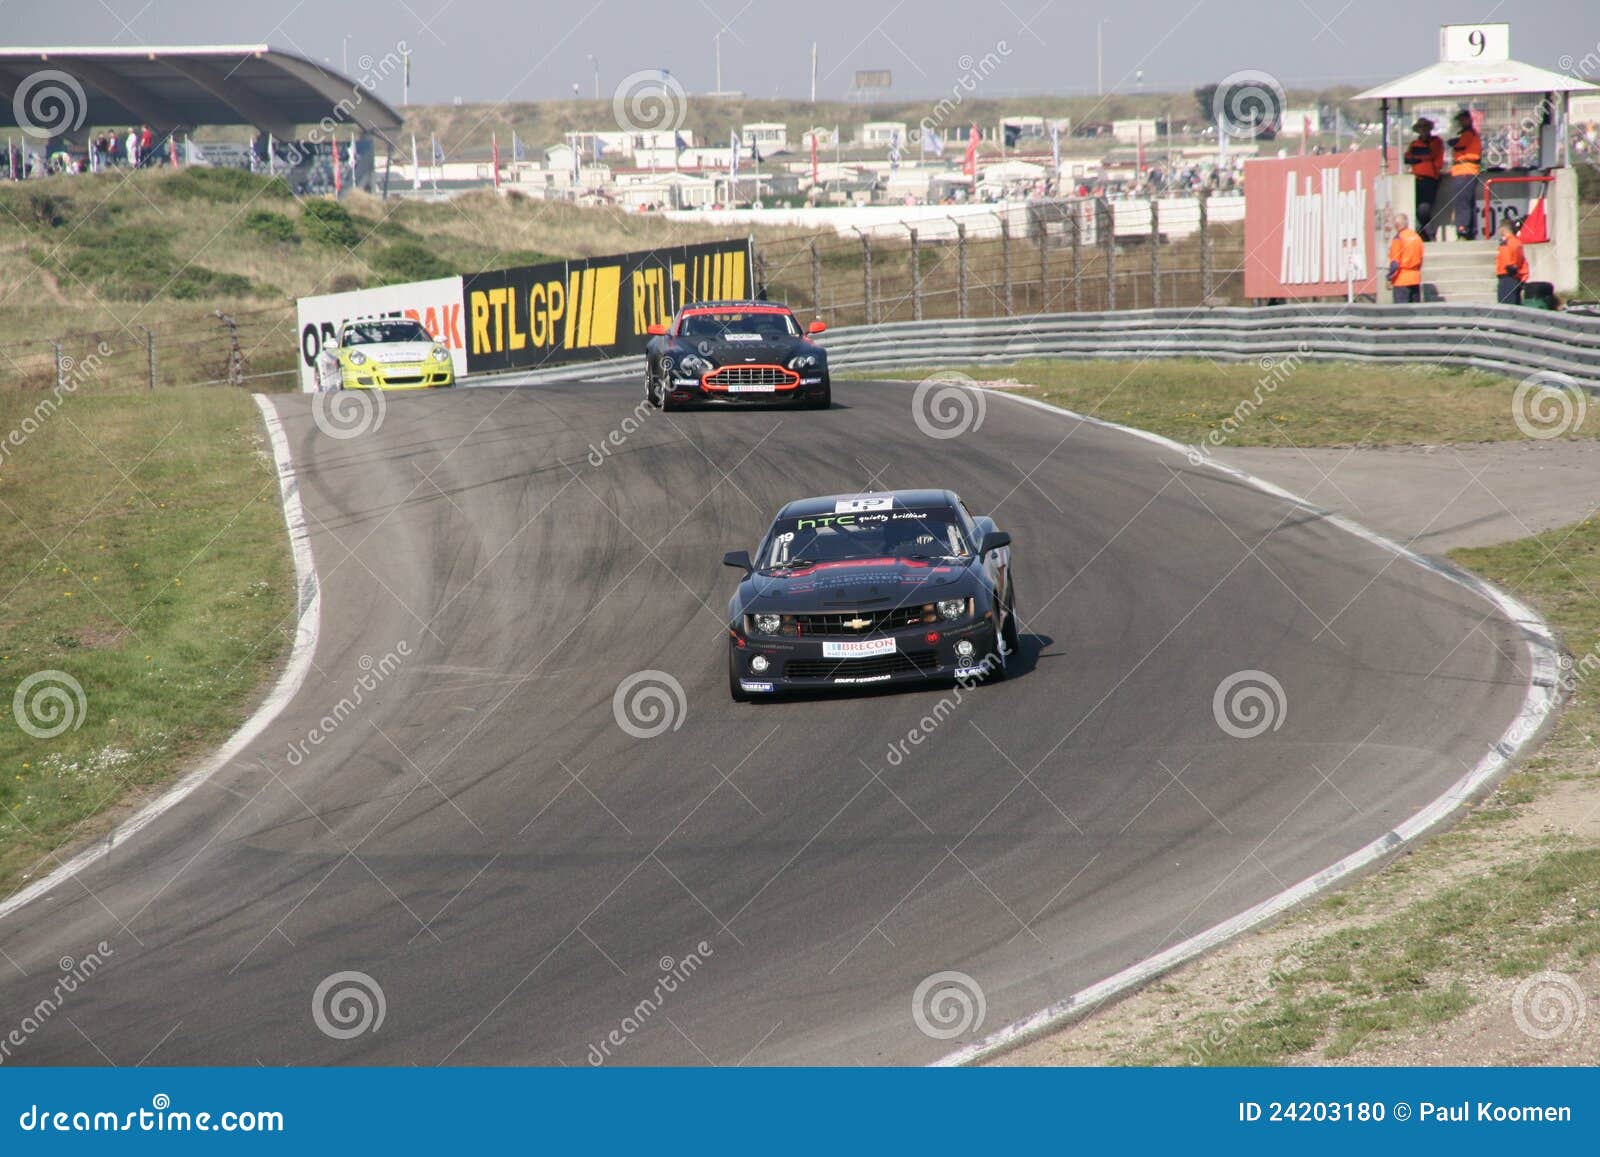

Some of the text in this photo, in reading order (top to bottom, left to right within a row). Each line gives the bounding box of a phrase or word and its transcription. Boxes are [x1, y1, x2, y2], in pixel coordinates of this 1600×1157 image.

[1467, 29, 1486, 57] 9
[471, 281, 566, 355] RTL GP
[778, 532, 795, 543] 19
[842, 638, 893, 650] BRECON
